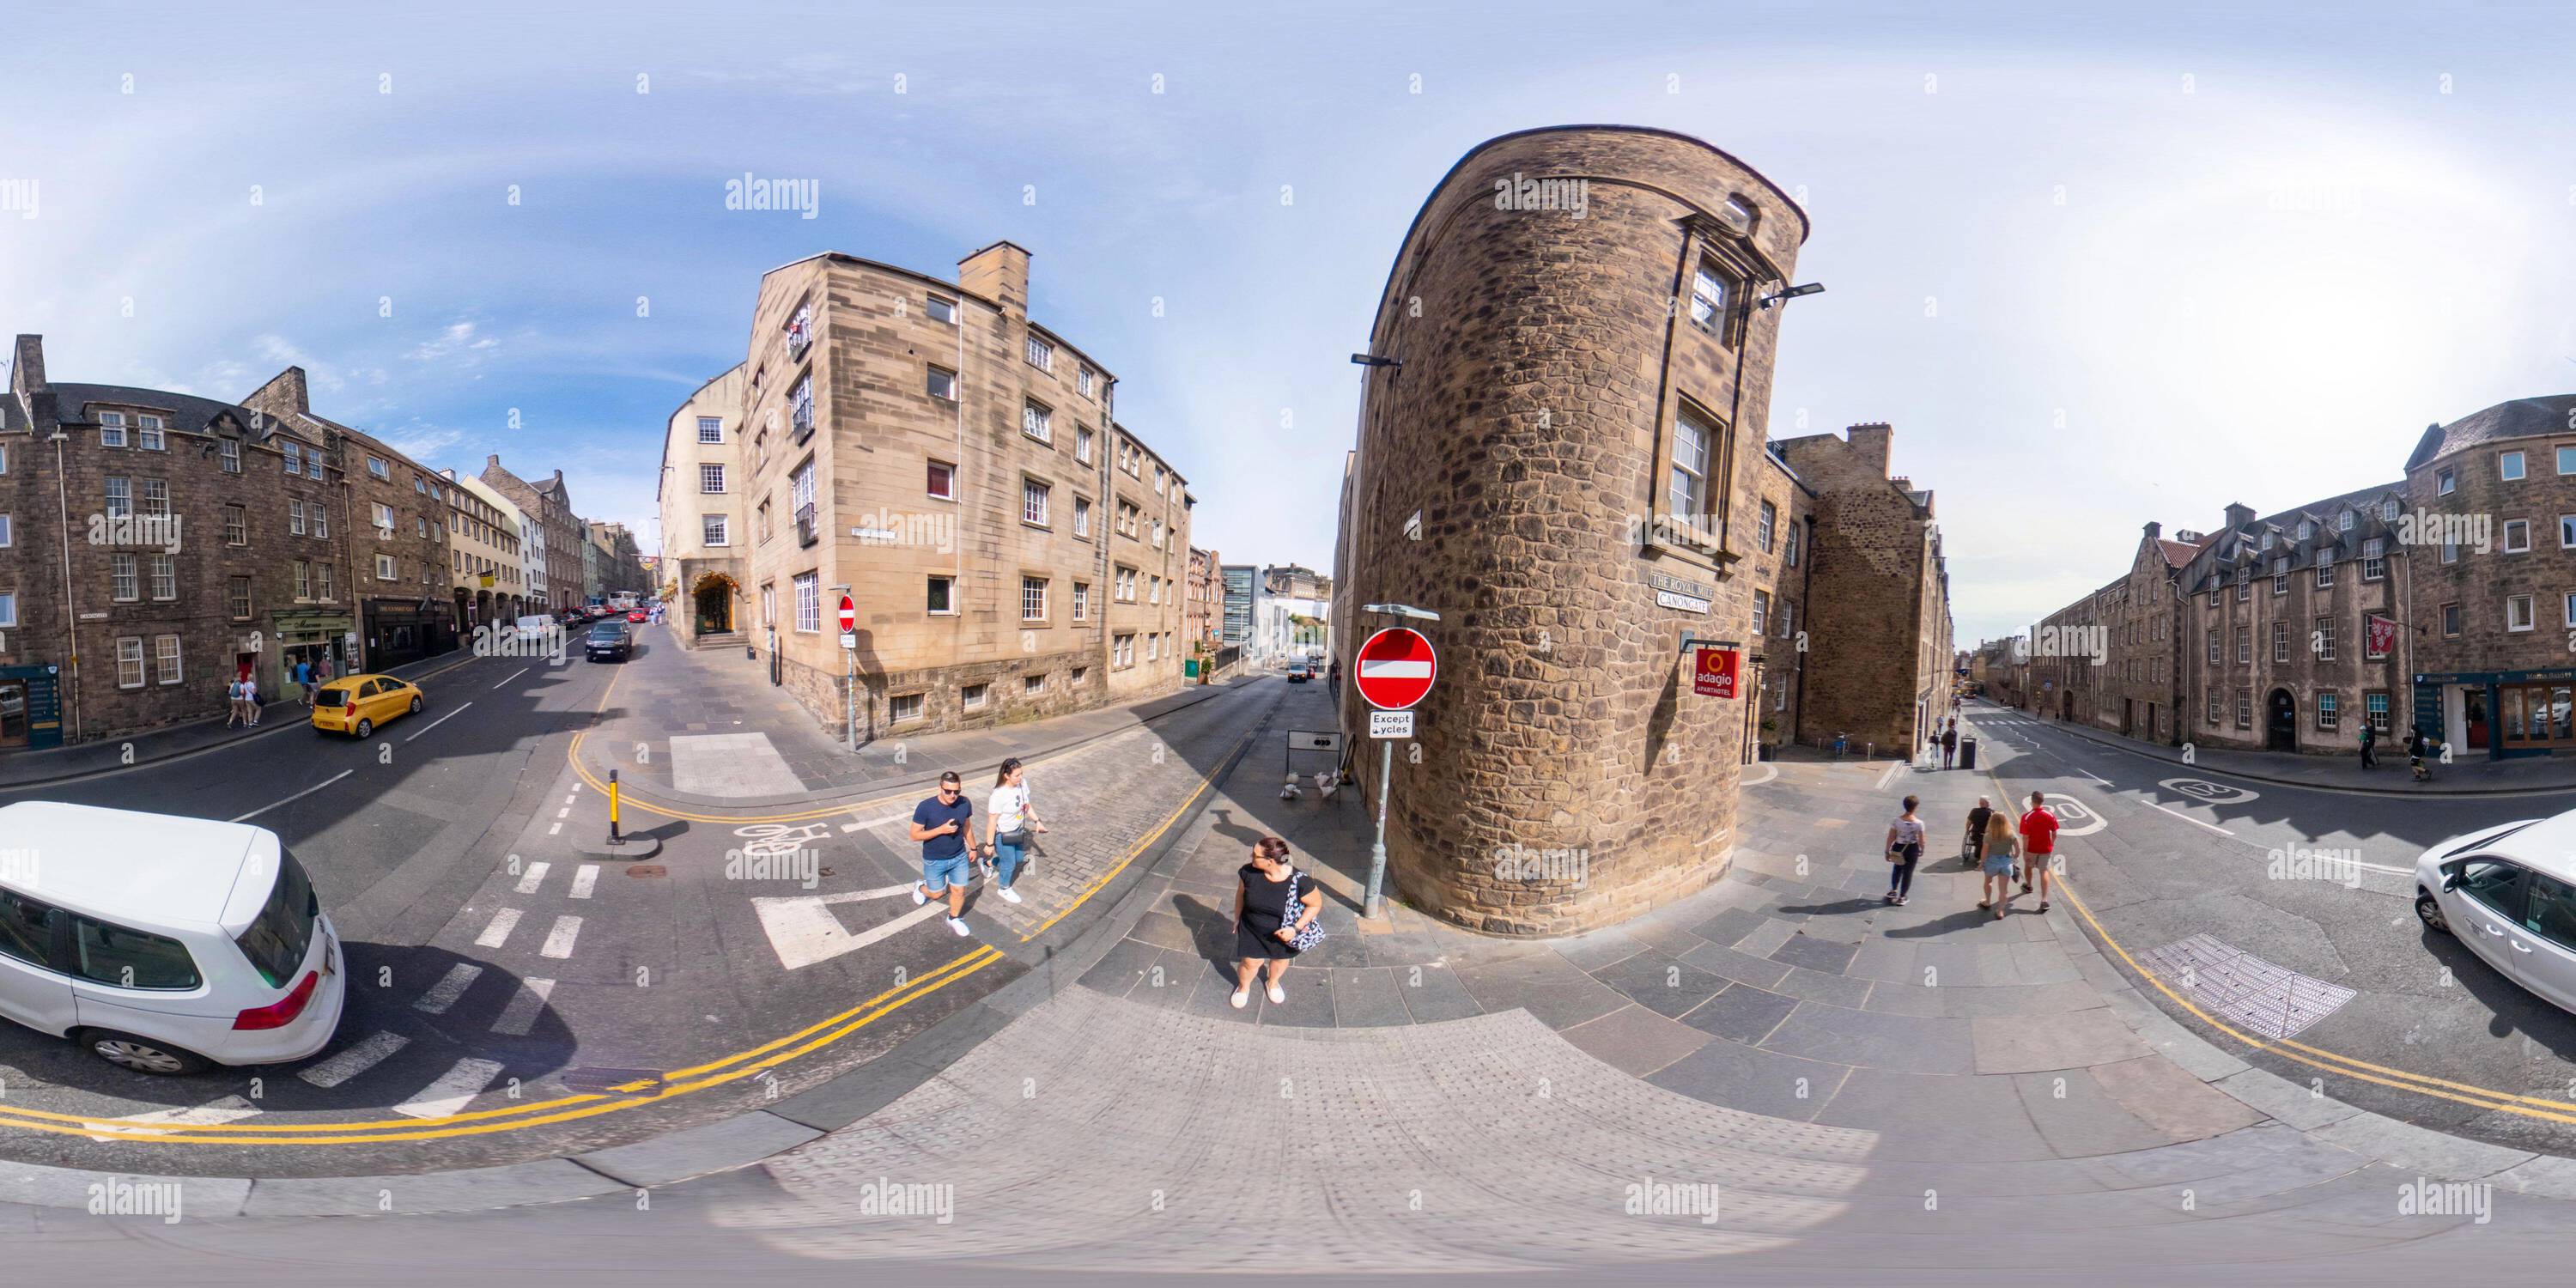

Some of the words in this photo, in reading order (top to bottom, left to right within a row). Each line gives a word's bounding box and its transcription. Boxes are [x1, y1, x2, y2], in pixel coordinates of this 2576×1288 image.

[1651, 574, 1669, 588] THE
[1670, 578, 1696, 595] ROYAL
[1697, 585, 1714, 598] MILE
[1660, 592, 1707, 612] CANONGATE
[1697, 671, 1732, 687] adagio
[1696, 686, 1732, 696] APARTHOTEL
[1374, 714, 1410, 724] Except
[1373, 726, 1407, 735] ycles
